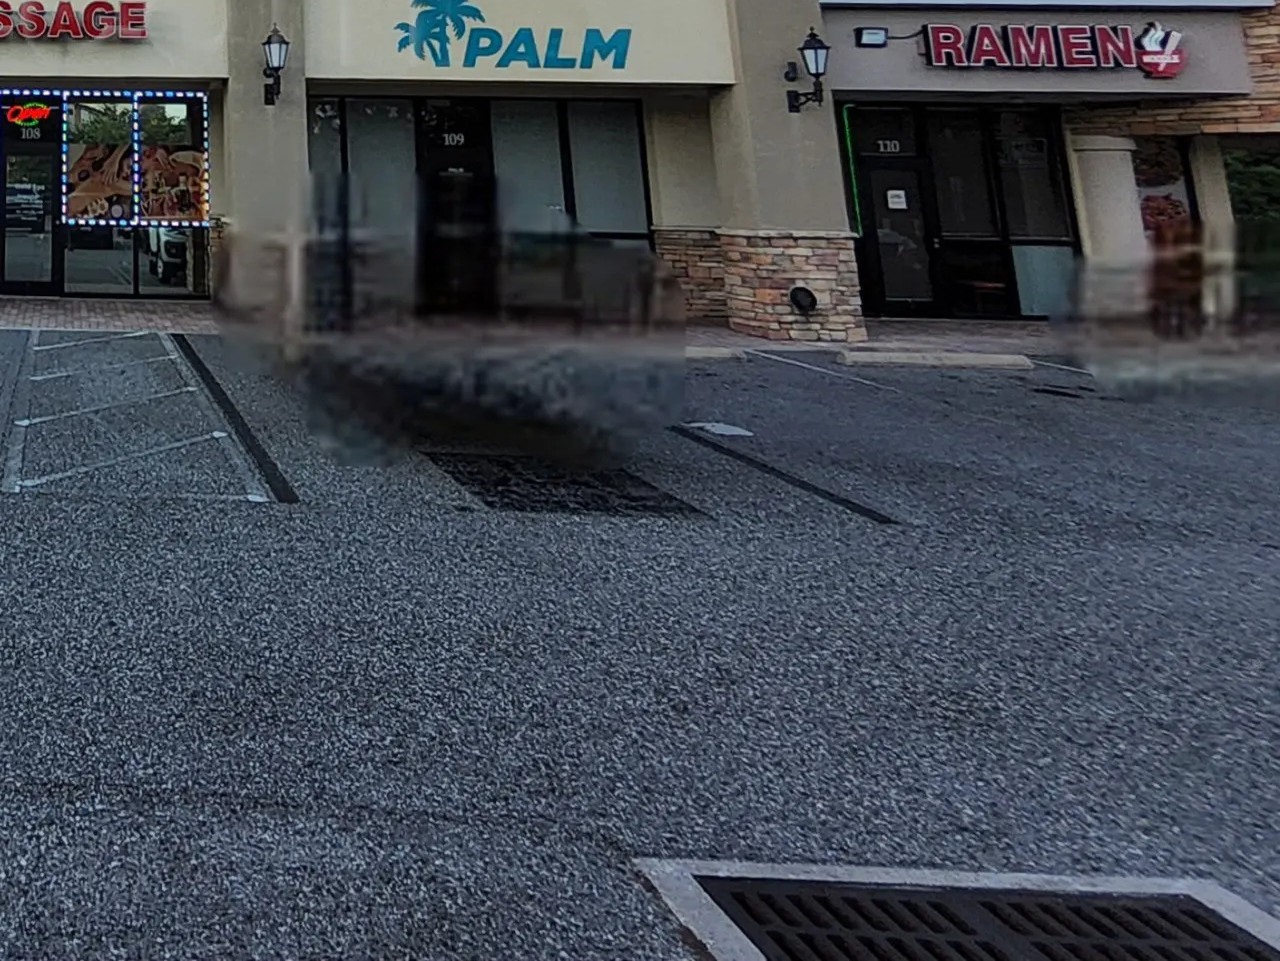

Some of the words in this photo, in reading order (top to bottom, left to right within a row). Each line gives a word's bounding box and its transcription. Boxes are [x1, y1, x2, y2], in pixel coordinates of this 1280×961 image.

[463, 28, 632, 70] PALM
[927, 23, 1138, 68] RAMEN
[20, 127, 42, 139] 108
[442, 133, 465, 146] 109
[876, 139, 900, 153] 110
